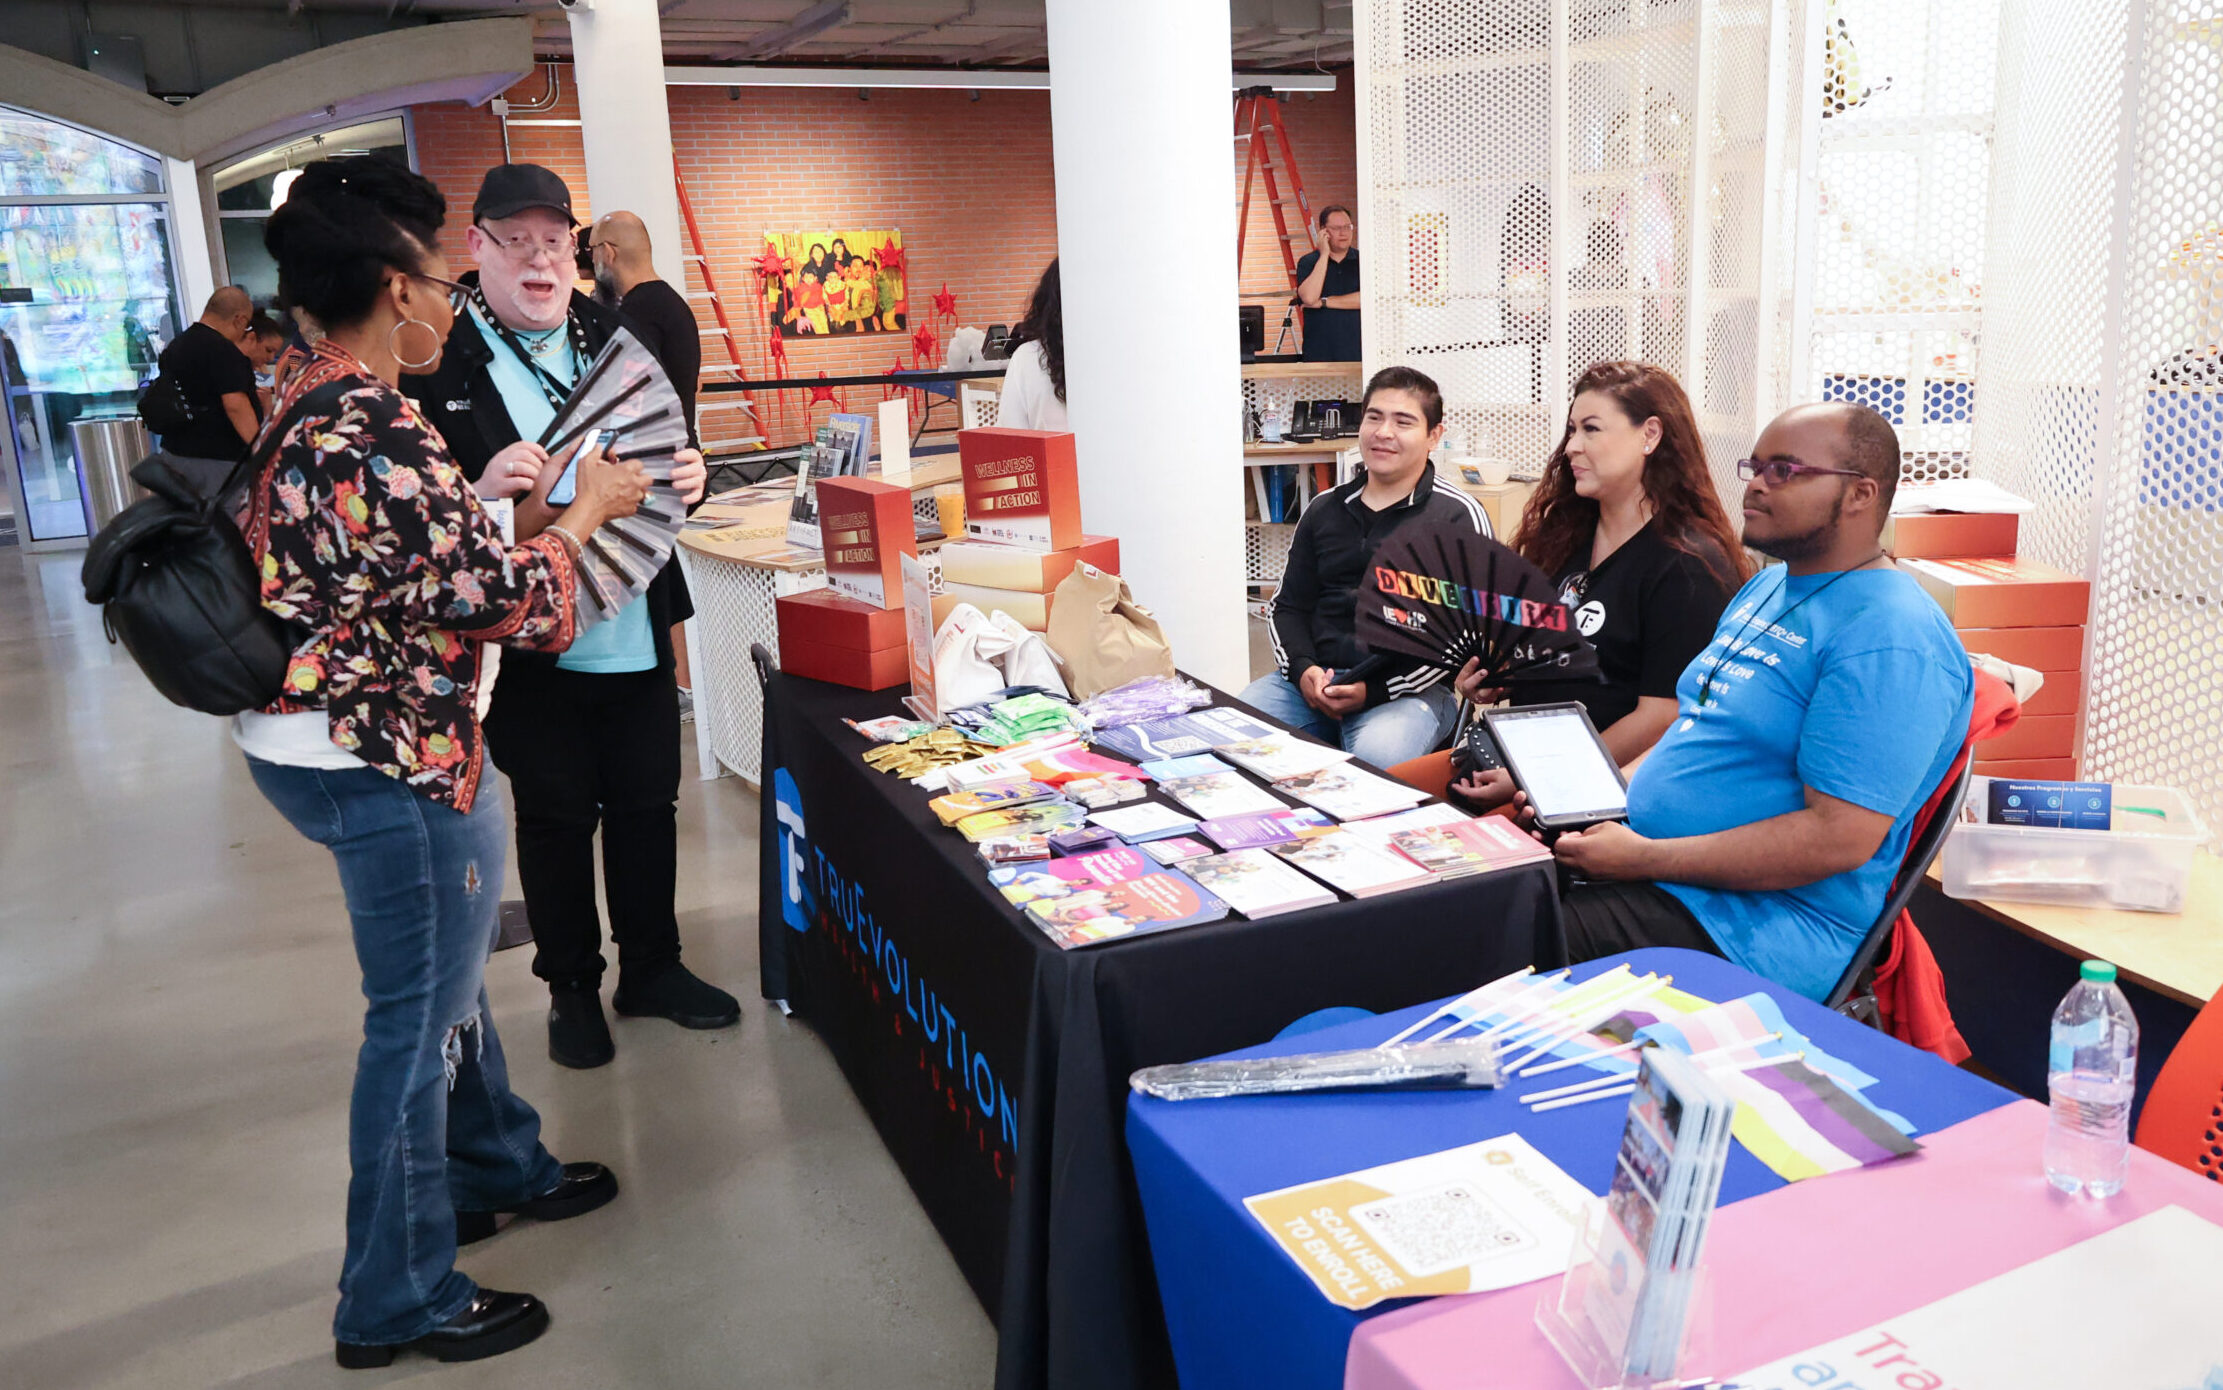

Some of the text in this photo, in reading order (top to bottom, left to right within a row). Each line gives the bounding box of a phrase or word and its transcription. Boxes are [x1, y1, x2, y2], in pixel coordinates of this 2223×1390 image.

[975, 456, 1035, 478] WELLNESS
[1021, 472, 1038, 488] IN
[997, 491, 1042, 510] ACTION
[827, 511, 870, 530] WELLNESS
[860, 529, 873, 543] IN
[845, 547, 876, 563] ACTION
[1376, 567, 1568, 632] DIVEITY
[815, 844, 1018, 1154] TRUEVOLUTION
[1284, 1216, 1369, 1300] TO ENROLL
[1311, 1206, 1405, 1291] SCAN HERE
[1854, 1331, 1962, 1390] Tra
